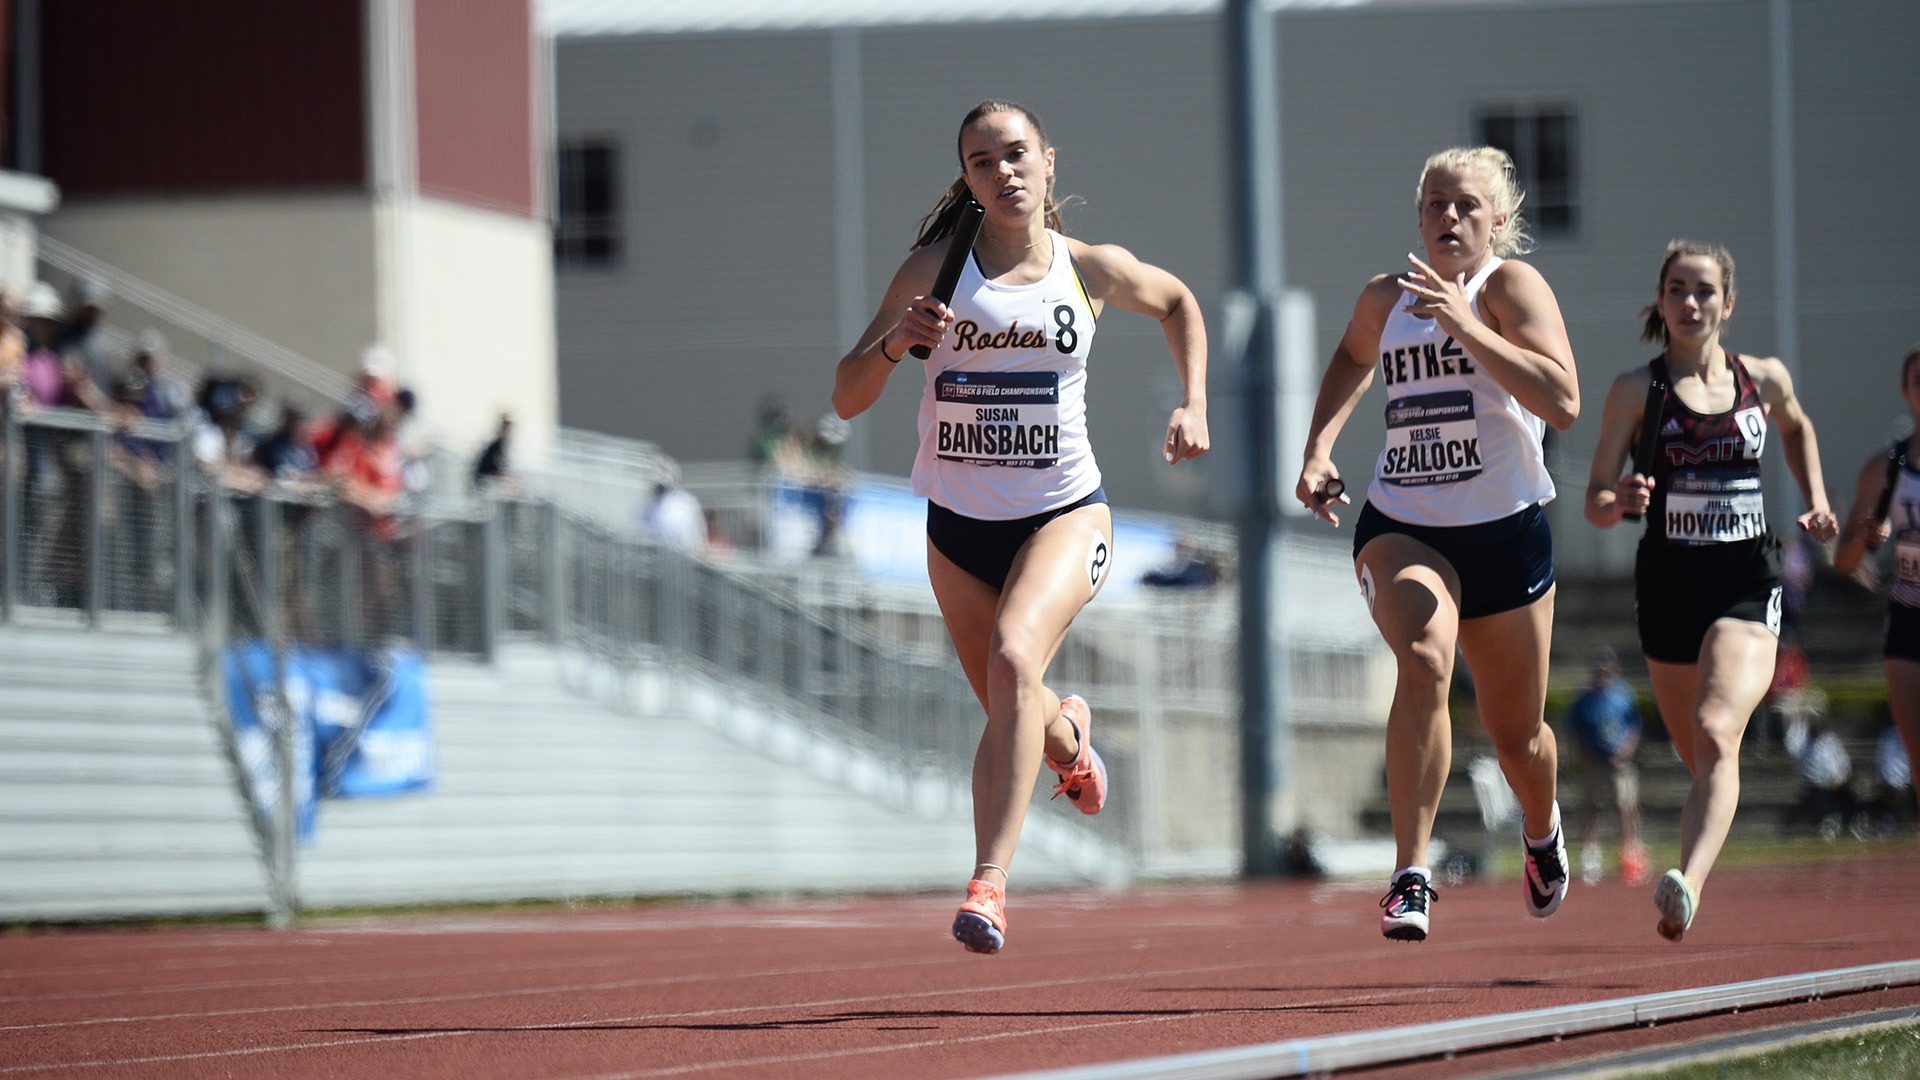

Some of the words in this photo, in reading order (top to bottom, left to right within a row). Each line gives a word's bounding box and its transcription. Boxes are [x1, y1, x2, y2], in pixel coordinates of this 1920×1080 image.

[952, 320, 1047, 351] Roches
[1053, 304, 1078, 355] 8
[956, 387, 976, 396] TRACK
[982, 387, 1000, 397] FIELD
[1000, 387, 1055, 396] CHAMPIONSHIPS
[975, 408, 1019, 422] SUSAN
[938, 421, 1059, 455] BANSBACH
[1410, 427, 1440, 442] KELSIE
[1745, 414, 1762, 453] 9
[1383, 438, 1481, 475] SEALOCK
[1668, 512, 1763, 537] HOWARTH
[1091, 542, 1107, 586] 8
